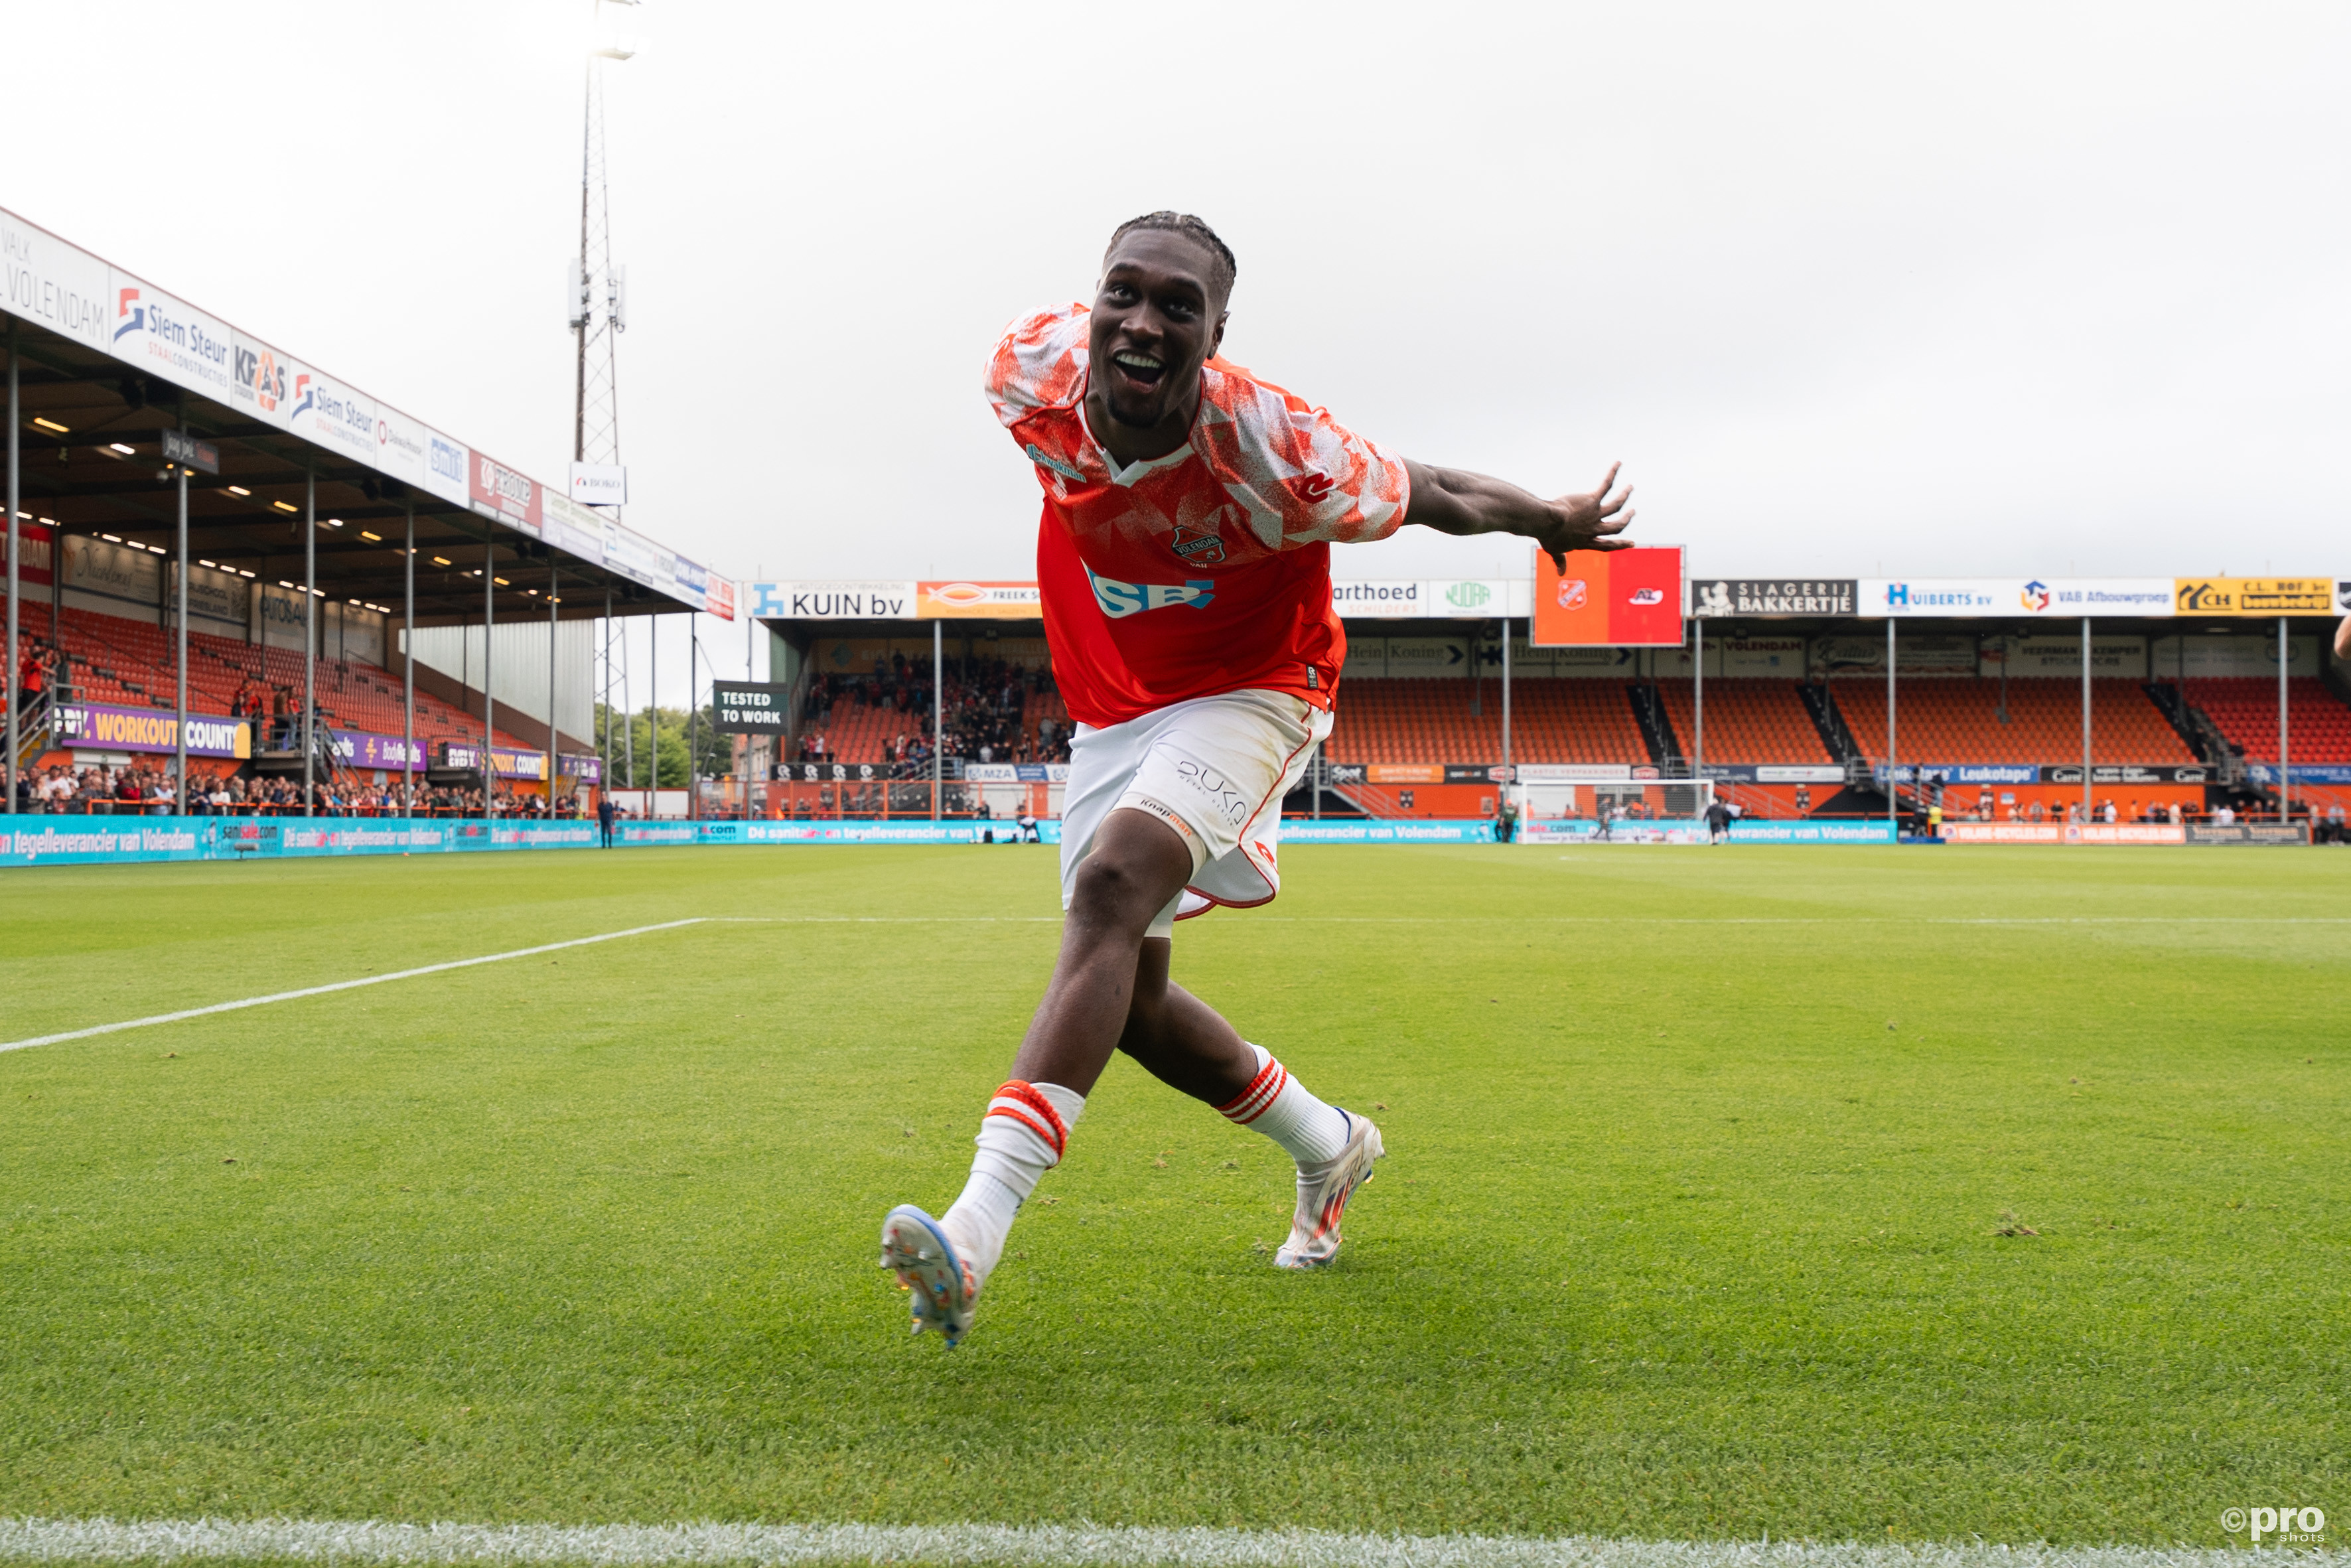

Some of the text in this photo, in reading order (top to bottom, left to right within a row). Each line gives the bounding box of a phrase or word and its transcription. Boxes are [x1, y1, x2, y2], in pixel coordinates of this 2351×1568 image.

[7, 263, 104, 341] VOLENDAM
[149, 303, 227, 366] Siem Steur
[148, 341, 228, 388] STAALCONSTRUCTIES
[317, 386, 372, 434] Siem Steur
[589, 478, 620, 488] BOKO
[1175, 537, 1220, 554] VOLENDAM
[1738, 583, 1851, 597] SLAGERIJ
[2277, 582, 2305, 591] HOF
[993, 591, 1028, 599] FREEK
[1977, 597, 1992, 605] BV
[2059, 591, 2170, 606] VAB Afbouwgroep
[2203, 593, 2231, 607] CH
[793, 594, 903, 615] KUIN bv
[1348, 604, 1417, 614] SCHILDERS
[1738, 597, 1851, 614] BAKKERTJE
[1348, 644, 1445, 661] Hein Koning
[1726, 641, 1802, 651] VOLENDAM
[721, 691, 771, 707] TESTED
[721, 709, 781, 725] TO WORK
[95, 713, 178, 747] WORKOUT
[516, 754, 541, 774] COUNT
[1959, 766, 2031, 783] Leukotape
[1140, 800, 1192, 837] Knapman
[223, 820, 277, 839] sanisale.com
[748, 826, 766, 839] Dé
[825, 829, 841, 839] en
[843, 827, 946, 841] tegelleverancier
[949, 829, 973, 839] van
[1277, 826, 1461, 841] gelleverancier van Volendam
[1795, 829, 1819, 839] van
[1821, 827, 1888, 839] Volendam
[14, 827, 118, 859] tegelleverancier
[119, 833, 140, 851] van
[142, 827, 195, 851] Volendam
